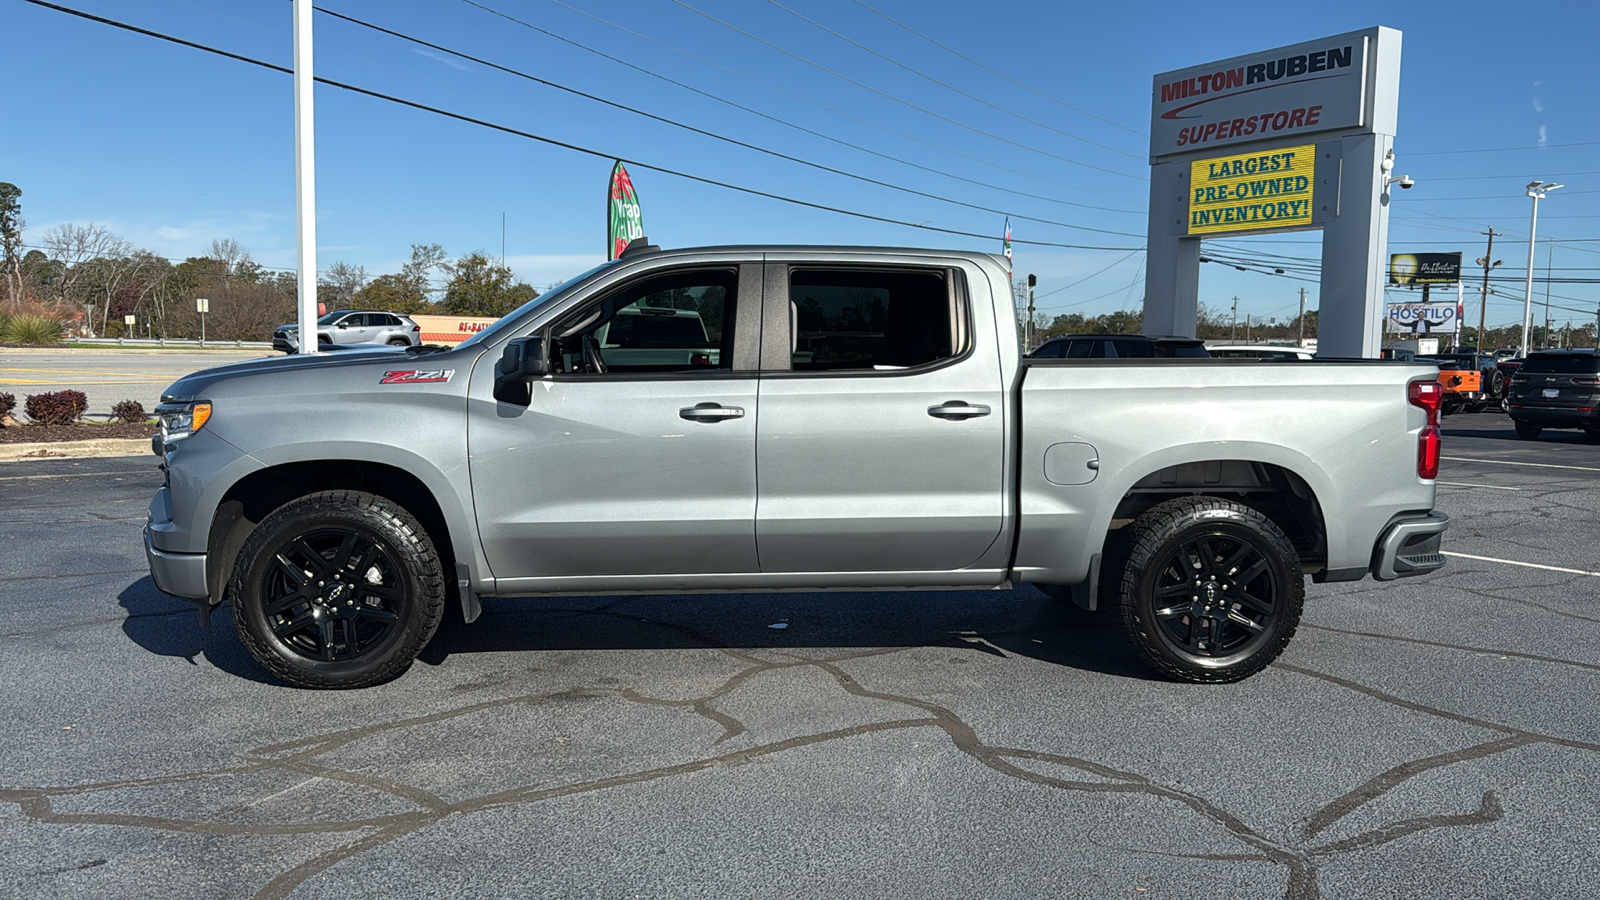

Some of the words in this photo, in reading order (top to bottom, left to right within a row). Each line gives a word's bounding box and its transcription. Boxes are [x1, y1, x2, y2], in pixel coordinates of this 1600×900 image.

[1161, 67, 1244, 103] MILTON
[1246, 46, 1352, 85] RUBEN
[1176, 105, 1323, 147] SUPERSTORE
[1209, 153, 1295, 179] LARGEST
[1194, 175, 1309, 203] PRE-OWNED
[1191, 200, 1309, 225] INVENTORY!
[1390, 308, 1454, 319] HOSTILO
[379, 369, 455, 384] Z71
